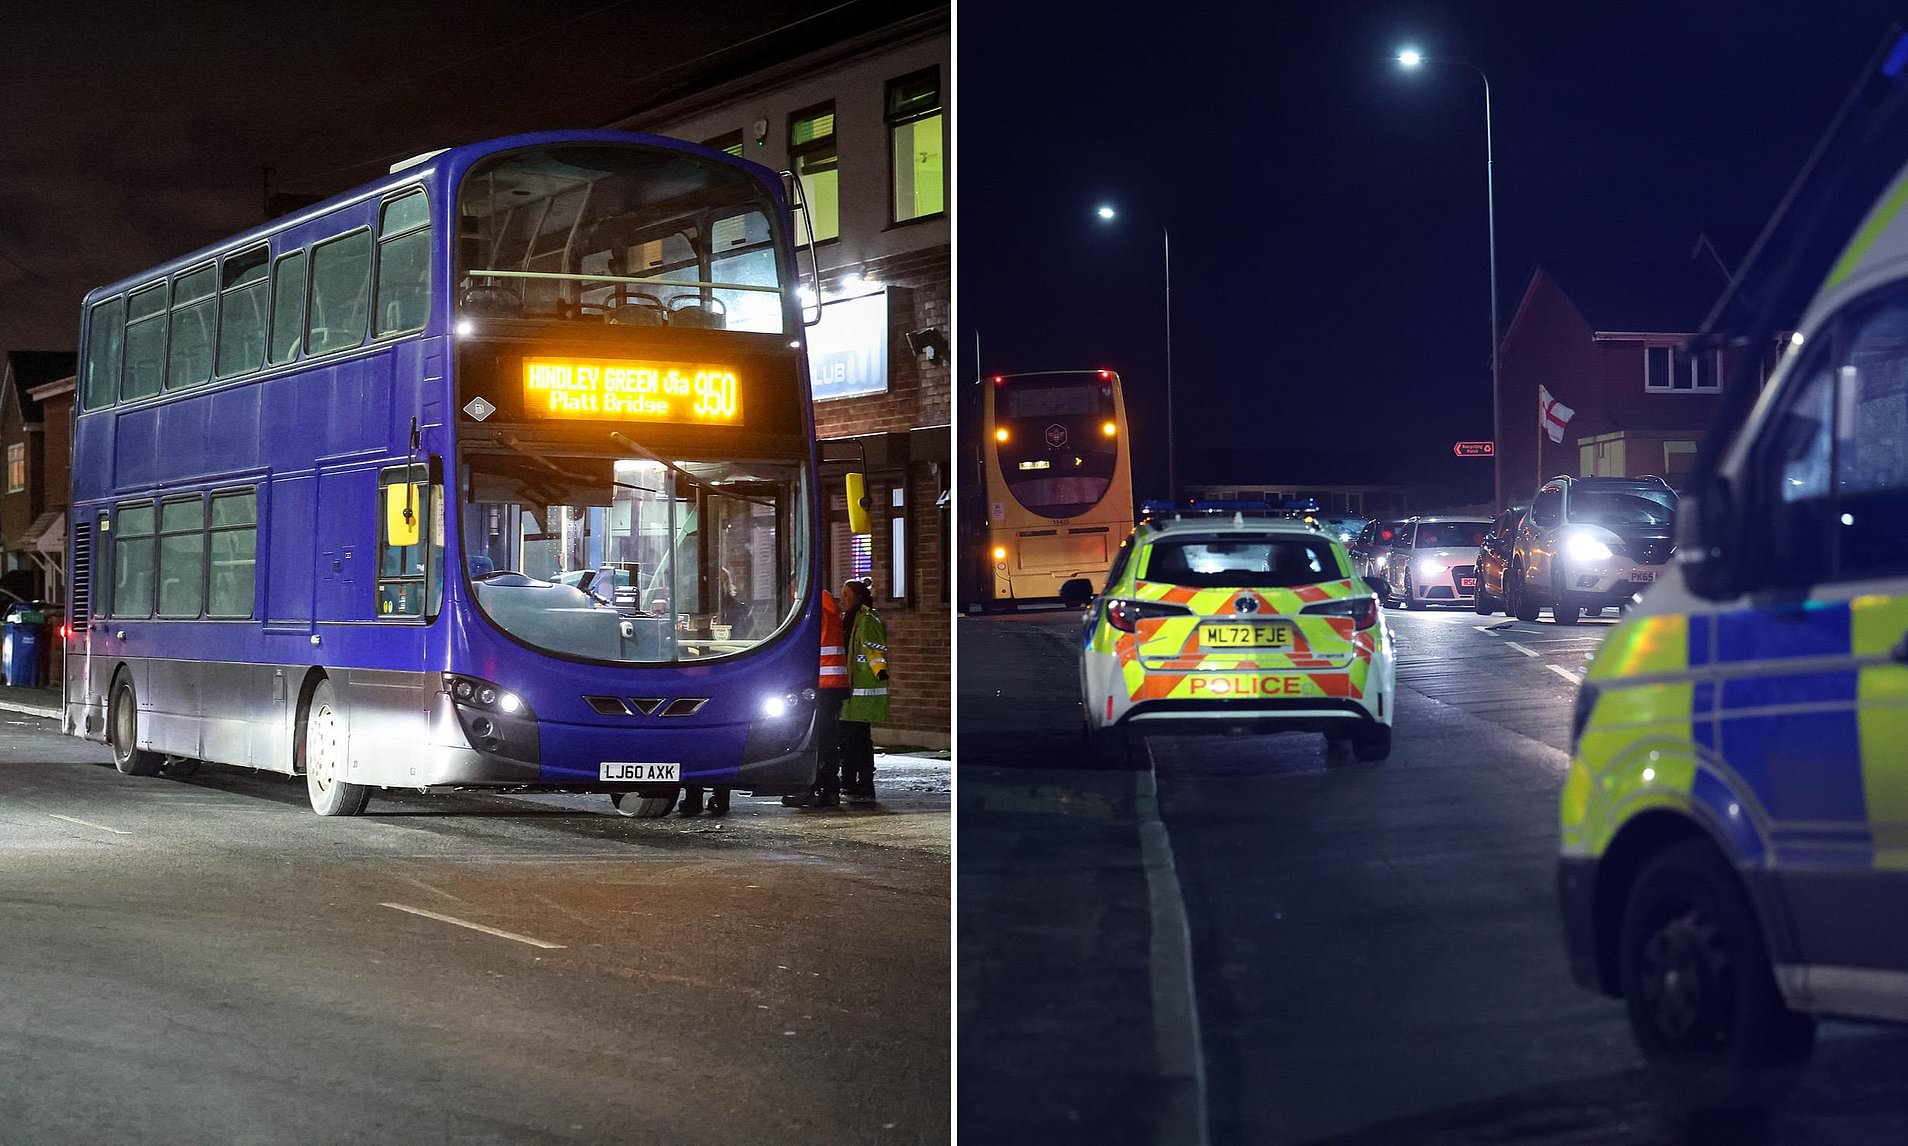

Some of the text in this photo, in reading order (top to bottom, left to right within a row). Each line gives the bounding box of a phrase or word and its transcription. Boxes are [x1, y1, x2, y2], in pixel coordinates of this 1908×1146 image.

[529, 365, 599, 390] HINDLEY
[604, 369, 659, 393] GREEN
[813, 362, 846, 386] LUB
[549, 390, 668, 414] Platt Bridge
[694, 371, 737, 416] 950
[1208, 628, 1286, 643] ML72 FJE
[1190, 676, 1301, 695] POLICE
[606, 765, 674, 779] LJ60 AXK
